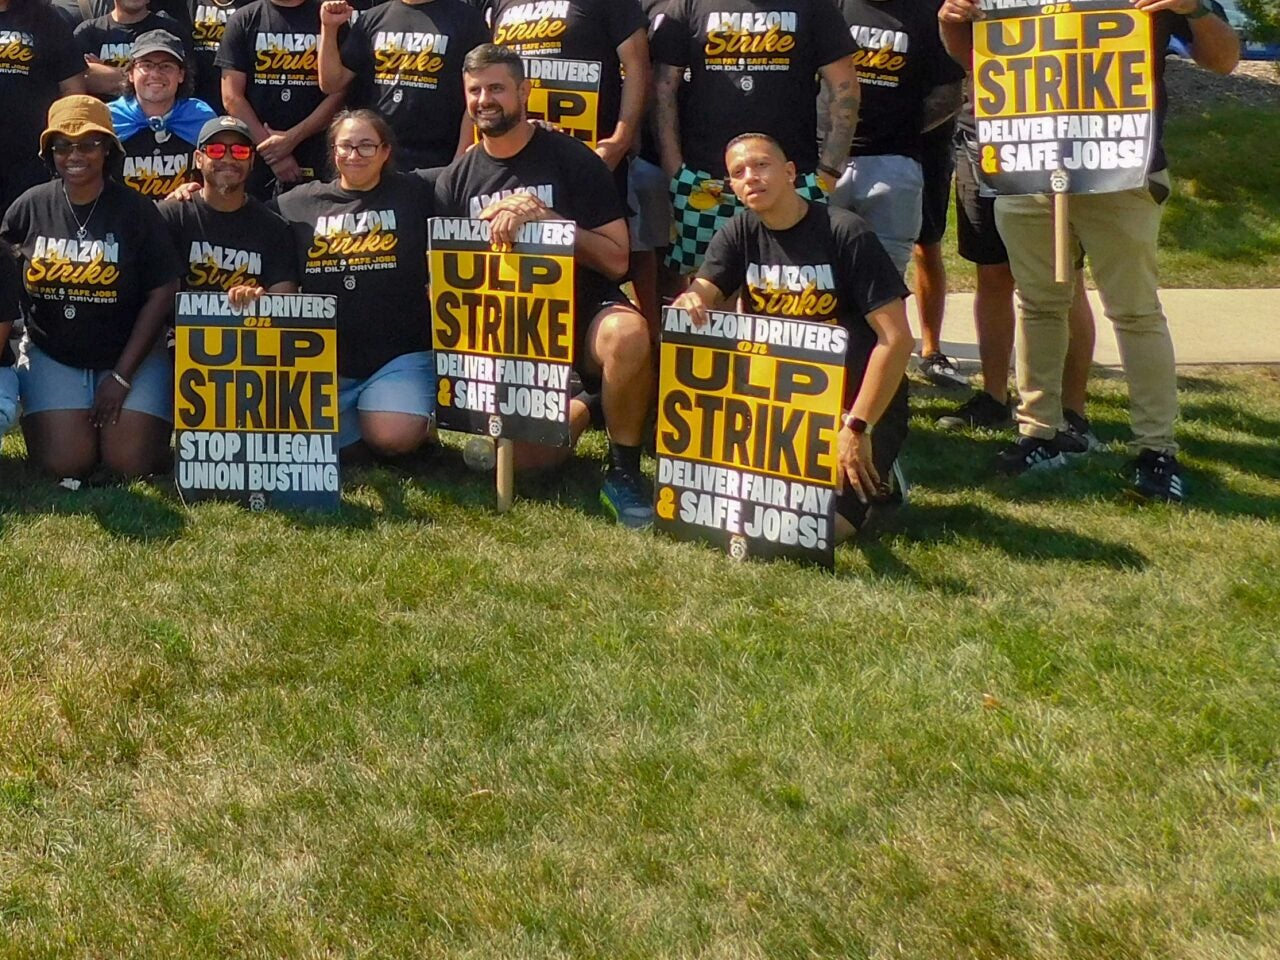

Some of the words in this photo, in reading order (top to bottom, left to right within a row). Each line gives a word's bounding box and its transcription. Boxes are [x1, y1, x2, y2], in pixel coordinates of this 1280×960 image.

[502, 1, 570, 25] AMAZON
[707, 12, 797, 32] AMAZON
[1041, 3, 1071, 14] on
[374, 32, 449, 54] AMAZON
[494, 16, 566, 45] Strike
[705, 23, 795, 55] Strike
[986, 12, 1135, 56] ULP
[375, 43, 443, 72] Strike
[531, 60, 599, 82] DRIVERS
[979, 51, 1146, 115] STRIKE
[979, 116, 1055, 143] DELIVER
[1057, 116, 1104, 139] FAIR
[1108, 114, 1148, 138] PAY
[981, 145, 997, 173] &
[1000, 142, 1059, 171] SAFE
[1063, 140, 1144, 170] JOBS!
[314, 210, 396, 236] AMAZON
[432, 219, 491, 240] AMAZO
[515, 222, 575, 245] RIVERS
[32, 236, 118, 263] AMAZON
[308, 223, 397, 258] Strike
[27, 248, 119, 284] Strike
[189, 241, 261, 274] AMAZON
[444, 253, 562, 293] ULP
[746, 262, 835, 290] AMAZON
[178, 295, 256, 318] AMAZN
[259, 296, 335, 318] DRIVERS
[748, 281, 837, 316] Strike
[243, 317, 272, 327] on
[436, 291, 569, 359] STRIKE
[755, 319, 848, 353] DRIVERS
[188, 328, 325, 367] ULP
[737, 341, 767, 354] on
[437, 353, 494, 382] DELIVER
[496, 358, 535, 383] FAIR
[538, 364, 569, 390] PAY
[675, 347, 829, 403] ULP
[179, 368, 334, 429] STRIKE
[438, 379, 451, 406] &
[454, 381, 496, 413] SAFE
[499, 387, 565, 422] JOBS!
[180, 432, 241, 461] STOP
[246, 433, 337, 463] ILLEGAL
[662, 390, 836, 482] STRIKE
[179, 462, 245, 489] UNION
[249, 464, 338, 491] BUSTING
[659, 458, 740, 499] DELIVER
[742, 474, 786, 506] FAIR
[790, 484, 832, 515] PAY
[657, 487, 674, 519] &
[680, 491, 741, 533] SAFE
[744, 506, 826, 550] JOBS!
